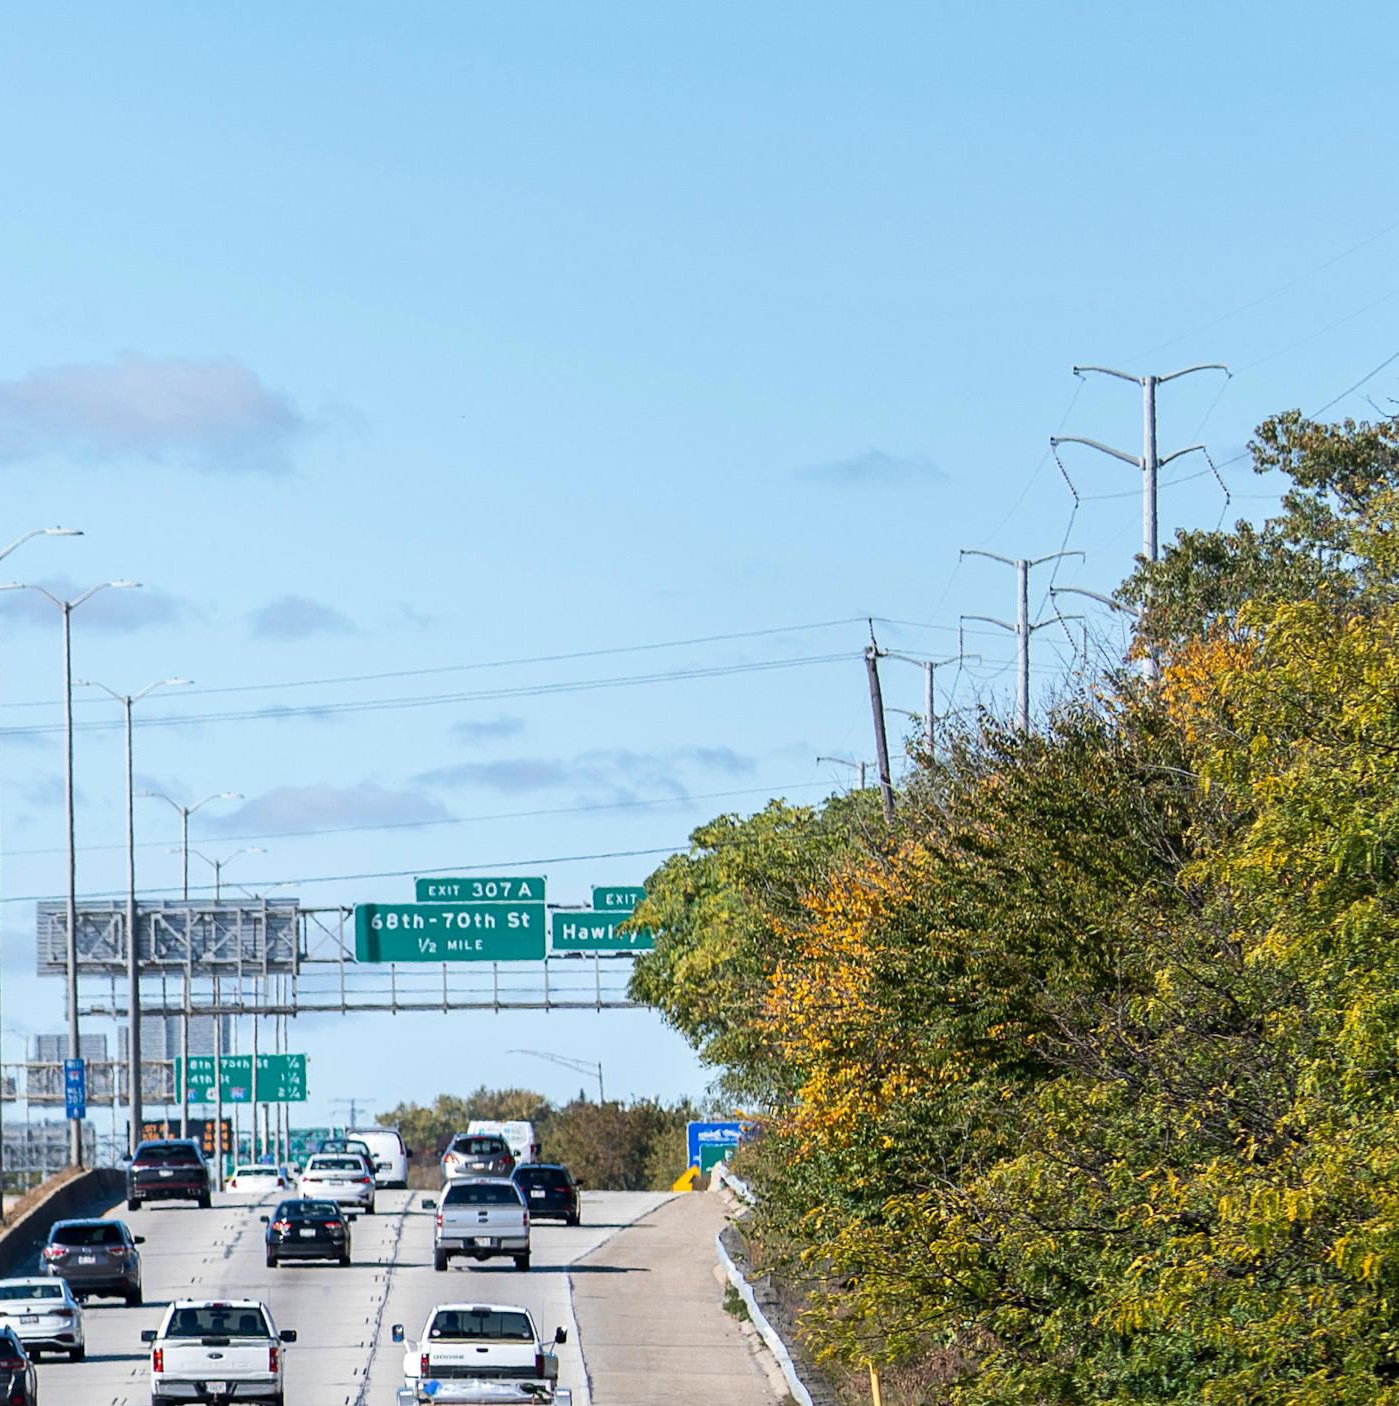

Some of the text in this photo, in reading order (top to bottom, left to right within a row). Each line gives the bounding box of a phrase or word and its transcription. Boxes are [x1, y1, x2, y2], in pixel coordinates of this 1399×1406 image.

[428, 885, 460, 897] EXIT
[605, 893, 638, 905] EXIT
[507, 911, 530, 928] St
[447, 939, 483, 951] MILE
